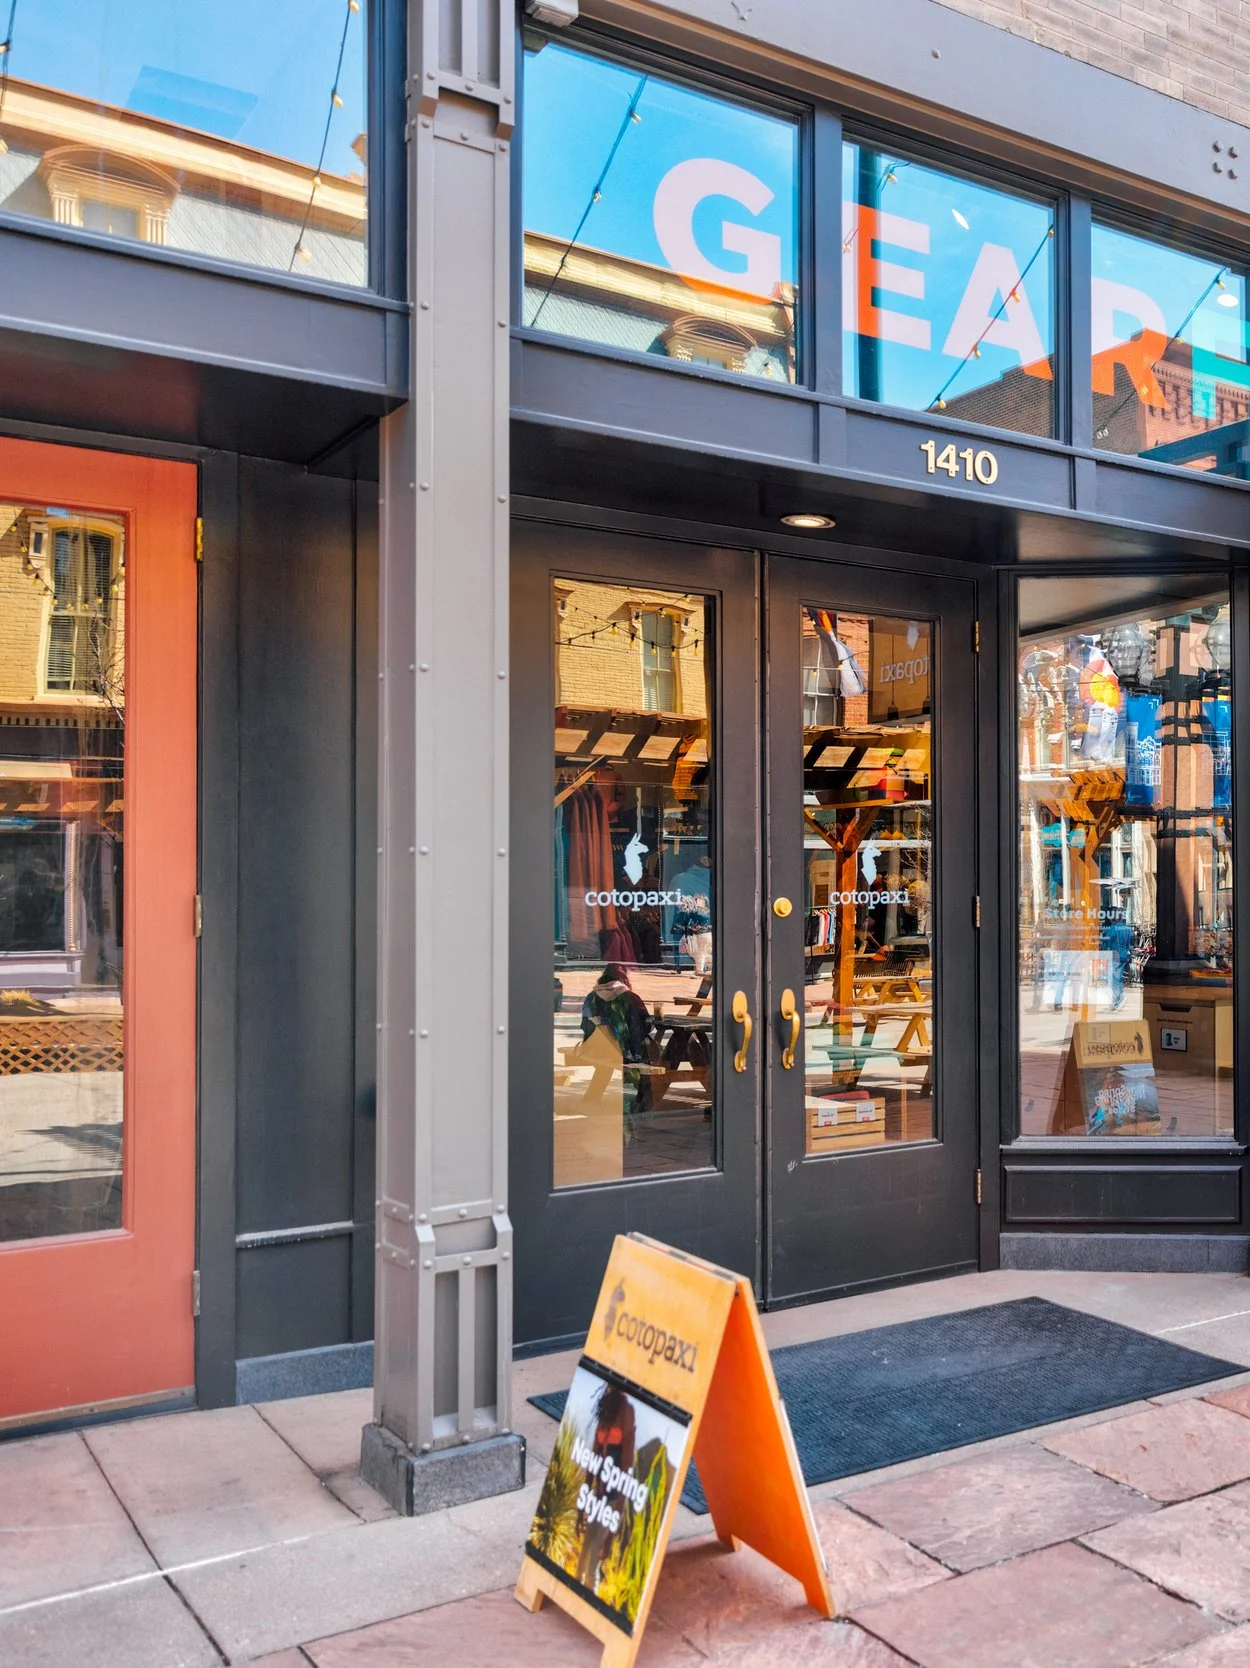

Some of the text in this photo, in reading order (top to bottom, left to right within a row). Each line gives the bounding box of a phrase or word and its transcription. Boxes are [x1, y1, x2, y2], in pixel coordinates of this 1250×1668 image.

[653, 157, 1171, 409] GEAR
[920, 440, 998, 485] 1410
[584, 885, 683, 912] cotopaxi
[829, 885, 911, 909] cotopaxi
[1045, 907, 1128, 920] Store Hours
[616, 1311, 699, 1373] cotopaxi
[570, 1436, 649, 1513] New Spring
[576, 1484, 621, 1534] Styles
